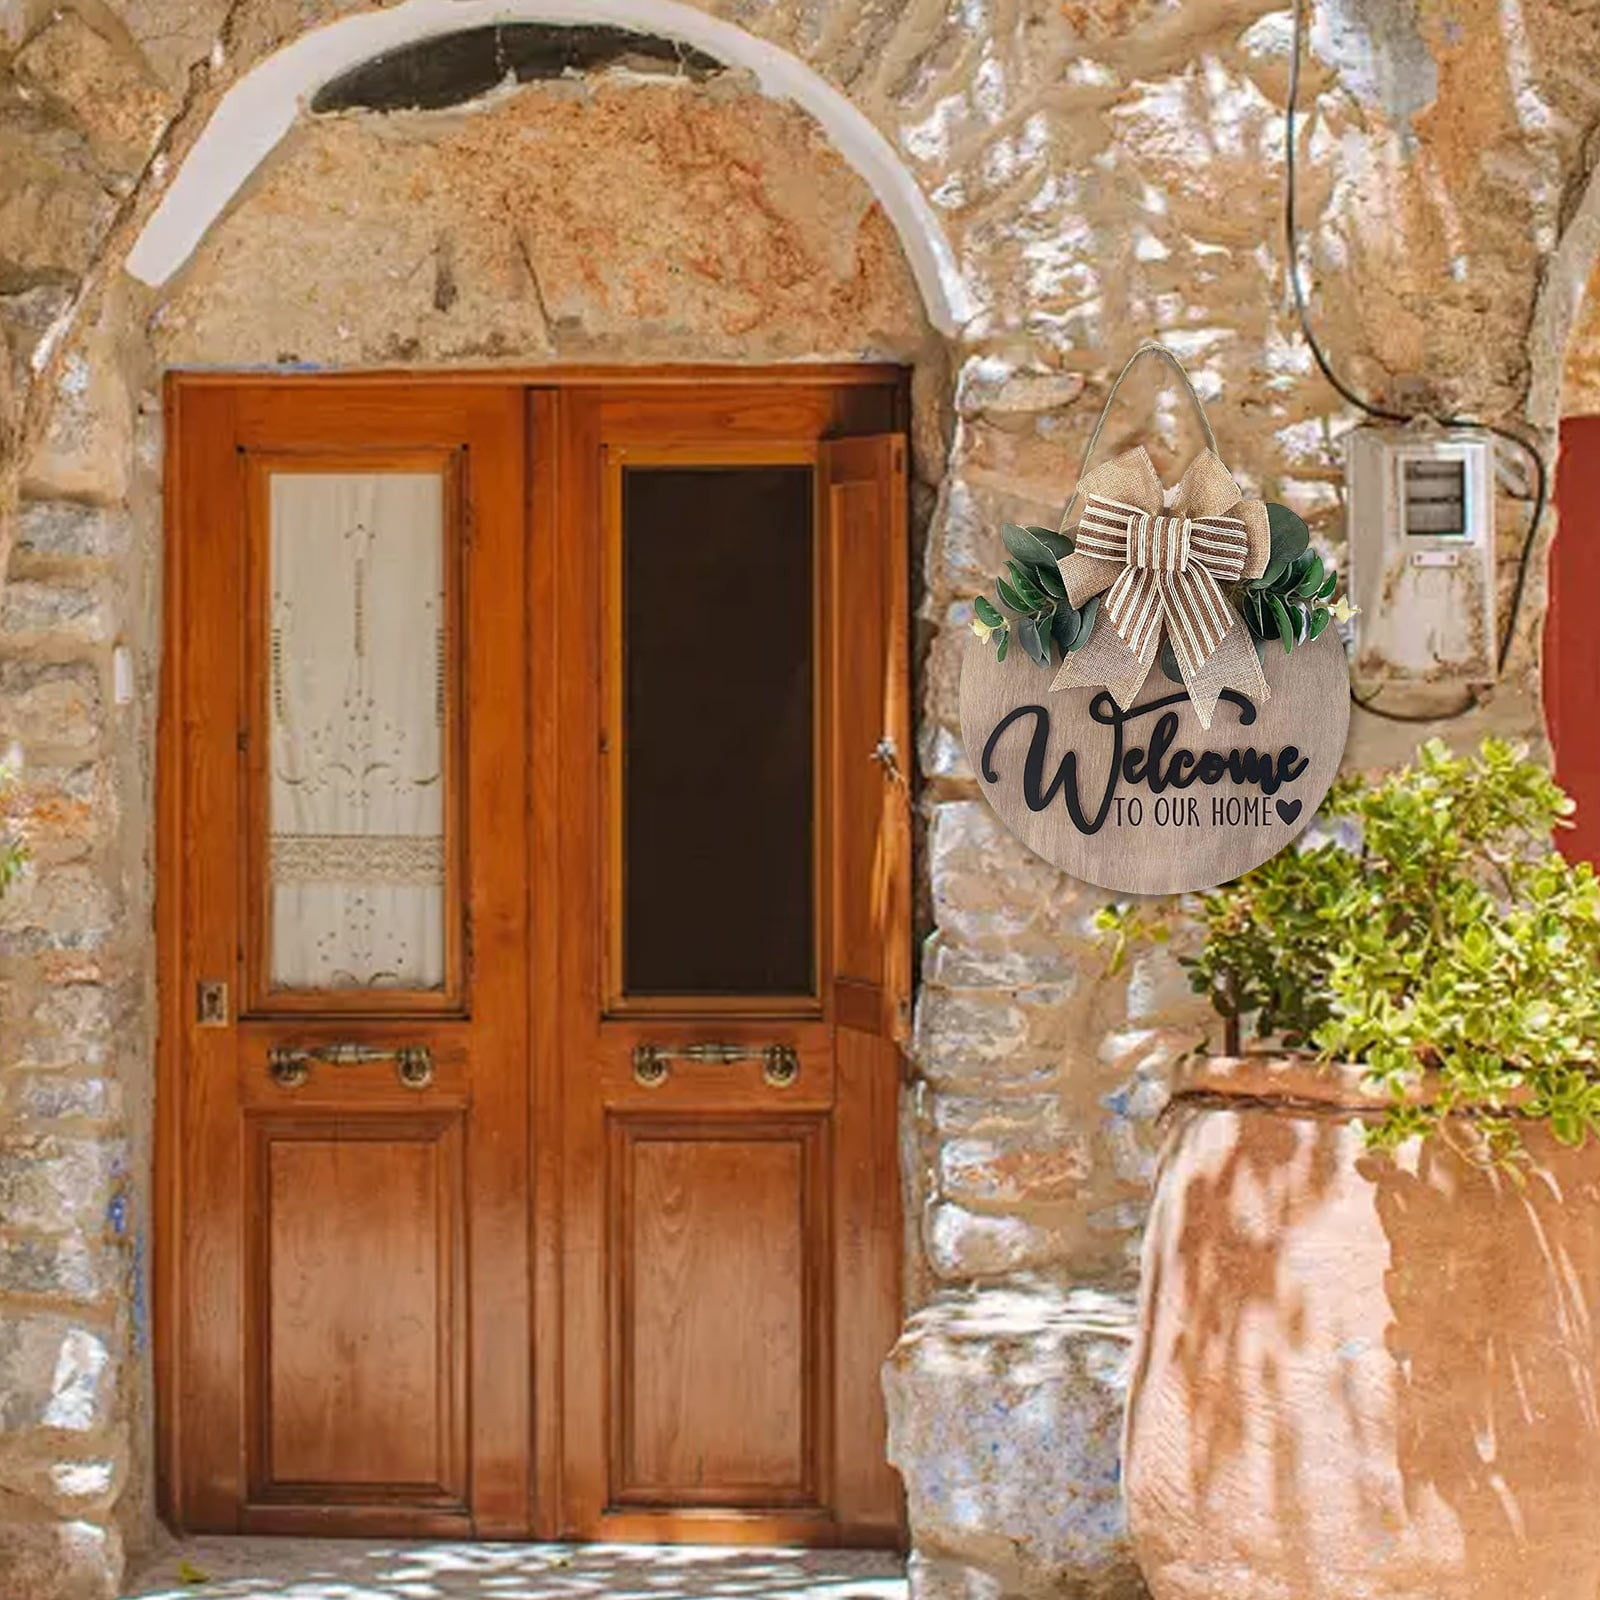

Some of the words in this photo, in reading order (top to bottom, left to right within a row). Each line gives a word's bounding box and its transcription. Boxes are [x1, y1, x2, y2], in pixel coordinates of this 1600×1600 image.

[981, 689, 1309, 835] Welcome
[1113, 797, 1143, 827] TO
[1154, 797, 1201, 827] OUR
[1211, 797, 1272, 827] HOME
